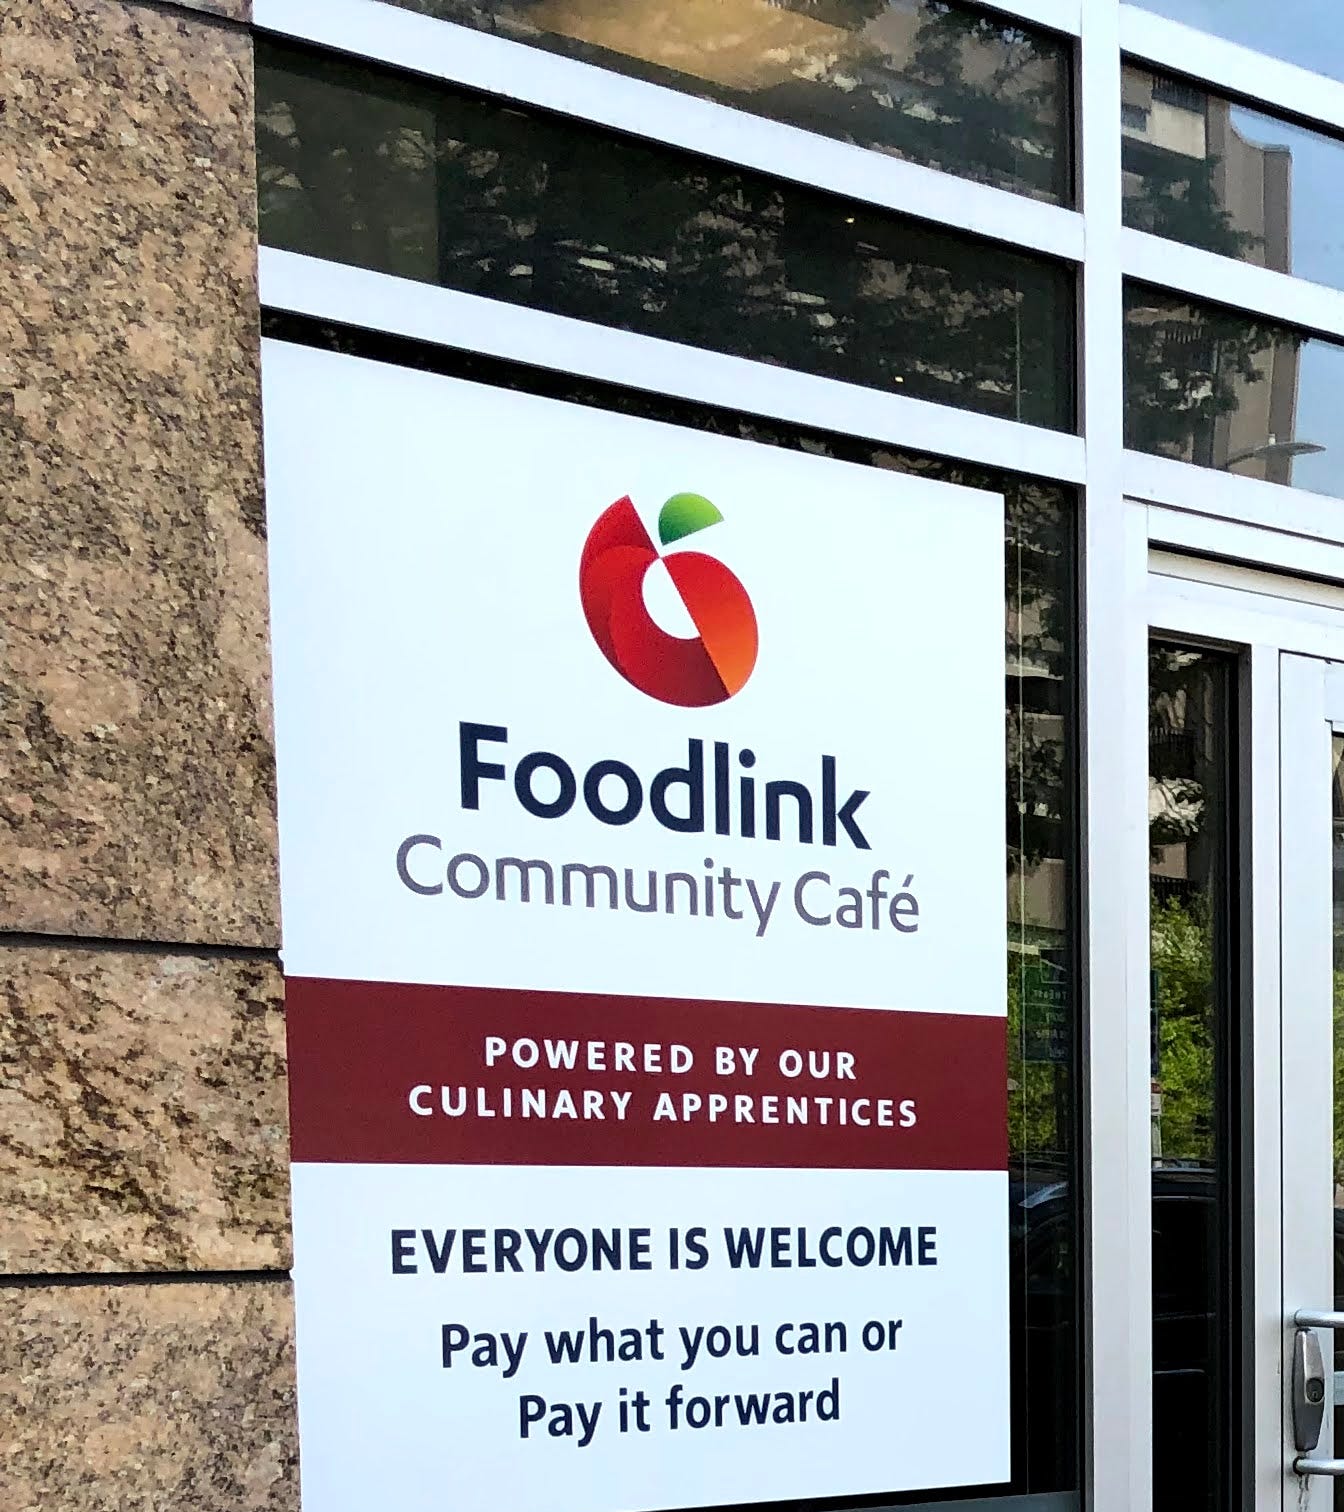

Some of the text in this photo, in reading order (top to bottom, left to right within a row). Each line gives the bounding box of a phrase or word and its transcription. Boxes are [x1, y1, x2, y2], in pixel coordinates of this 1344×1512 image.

[459, 721, 872, 850] Foodlink
[396, 833, 920, 937] Community Café
[485, 1037, 857, 1080] POWERED BY OUR
[408, 1085, 918, 1128] CULINARY APPRENTICES
[391, 1226, 937, 1274] EVERYONE IS WELCOME
[441, 1316, 902, 1378] Pay what you can or
[519, 1378, 840, 1448] Pay it forward
